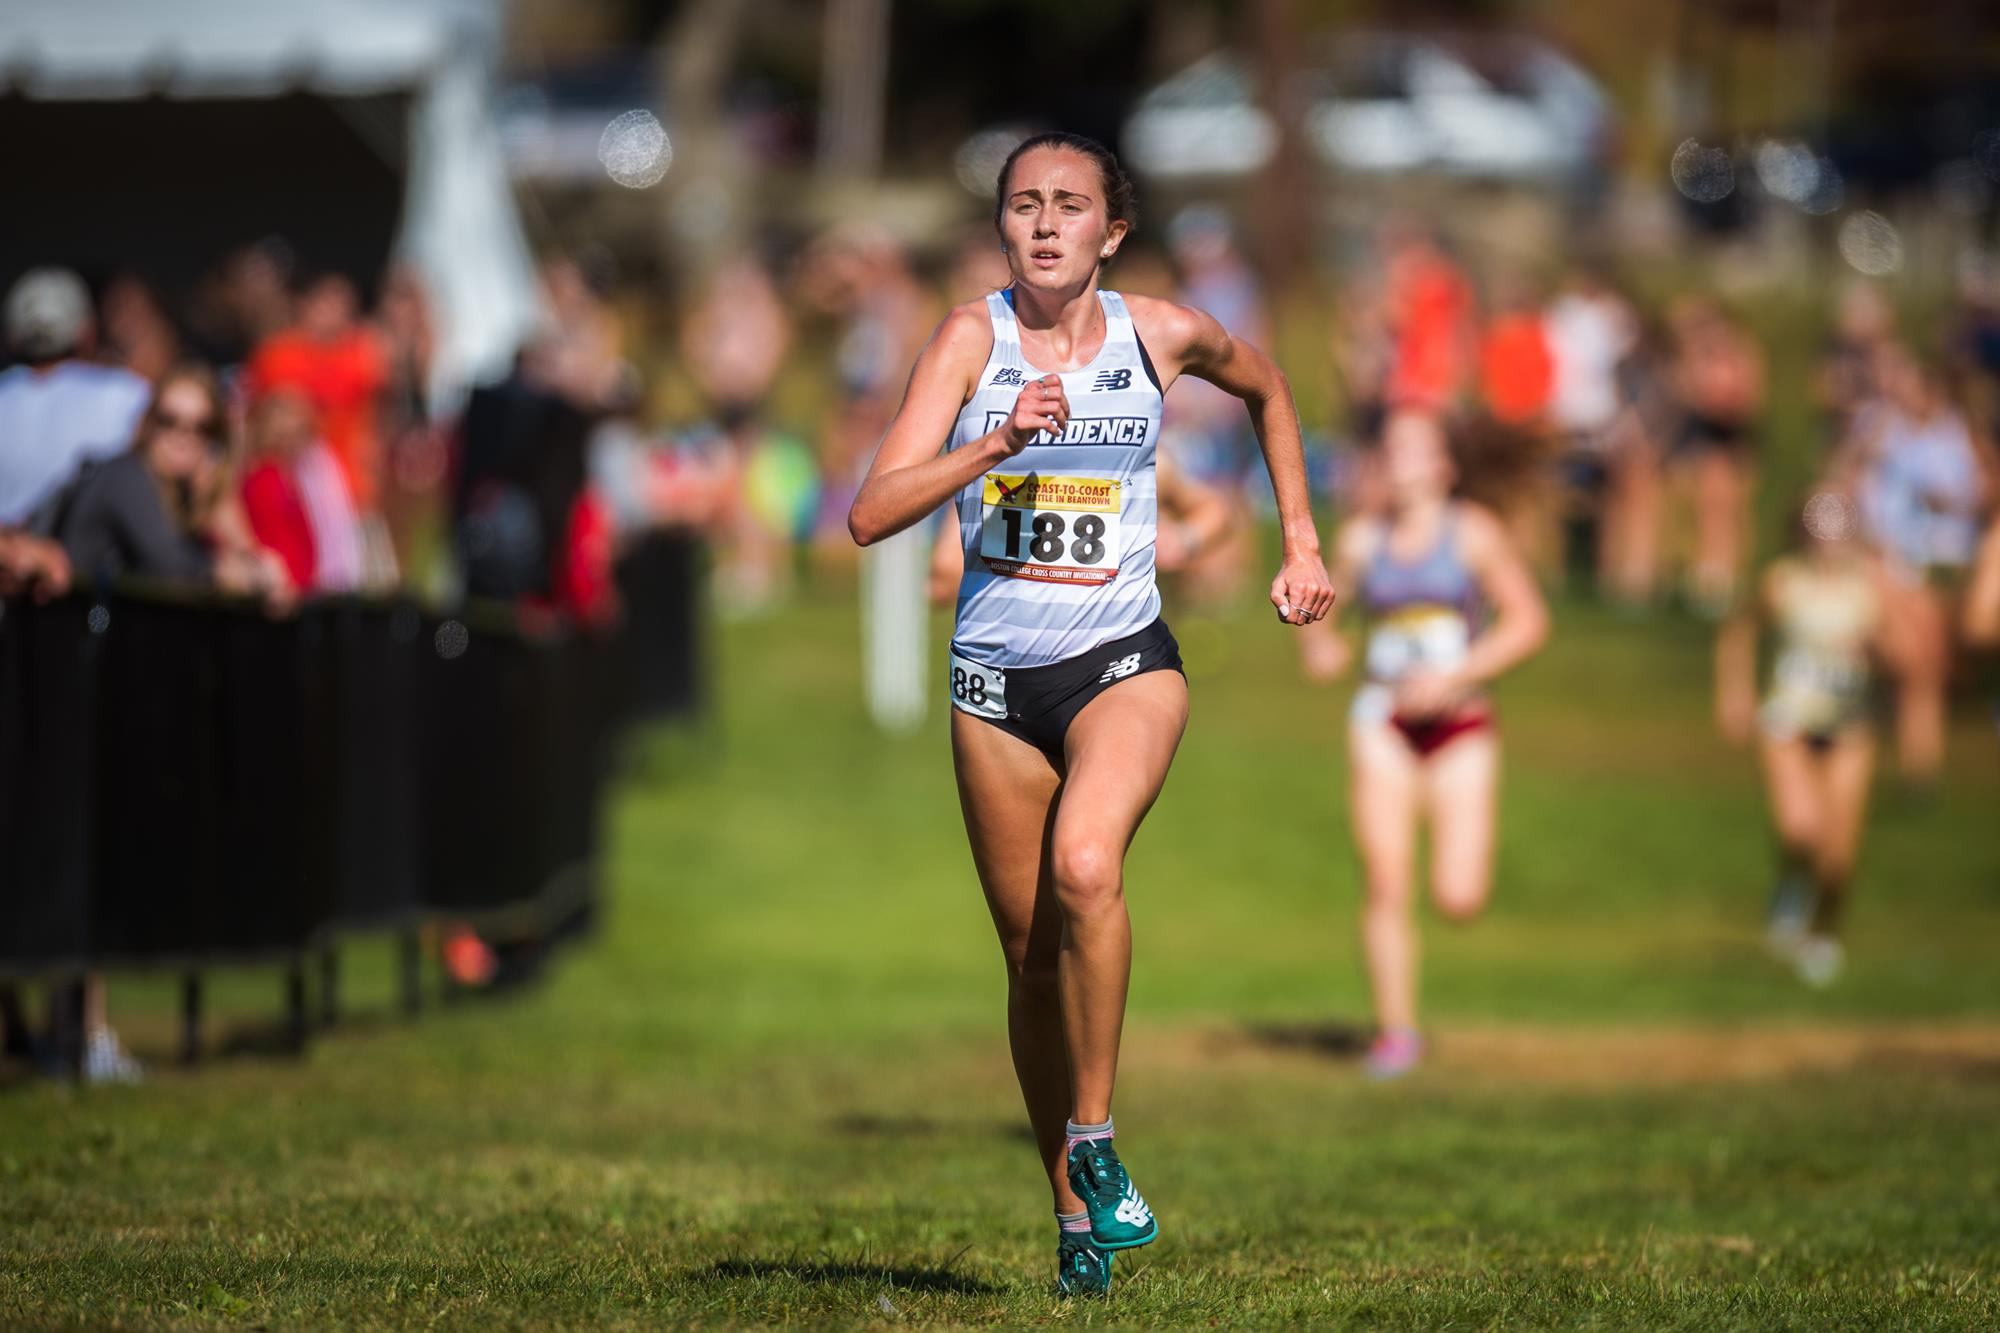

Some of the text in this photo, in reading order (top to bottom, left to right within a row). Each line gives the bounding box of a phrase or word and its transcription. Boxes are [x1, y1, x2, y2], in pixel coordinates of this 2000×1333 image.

[998, 367, 1023, 378] BIG
[992, 374, 1029, 386] EAST
[983, 411, 1148, 447] PVIDENCE
[1028, 483, 1111, 497] COAST-TO-COAST
[1026, 493, 1111, 505] BATTLE IN BEANTOWN
[1001, 509, 1106, 565] 188
[1032, 568, 1049, 577] CROSS
[1049, 570, 1073, 579] COUNTRY
[953, 666, 988, 706] 88
